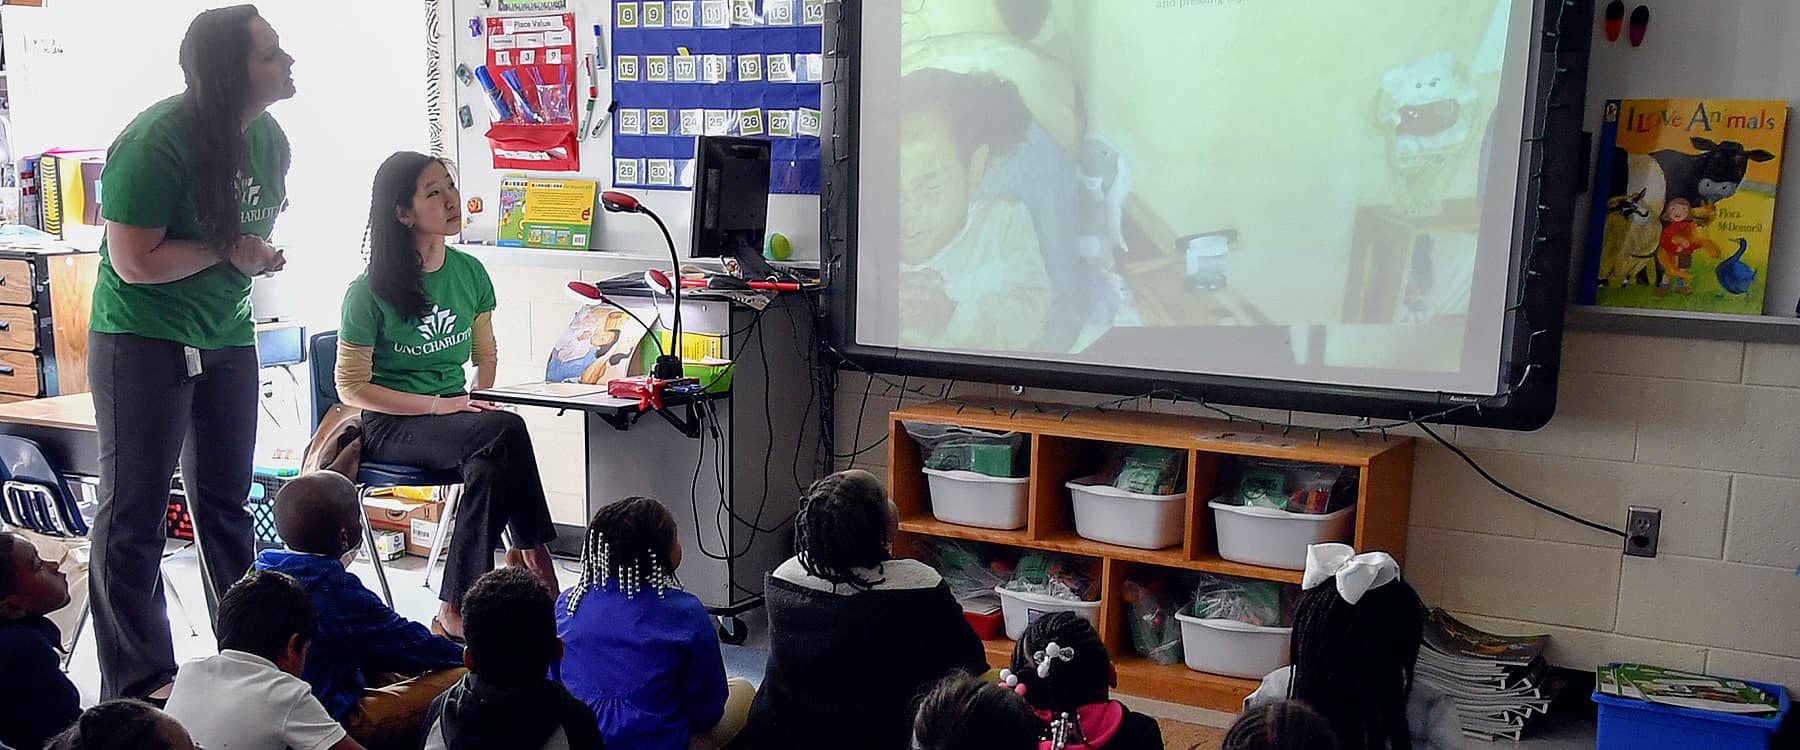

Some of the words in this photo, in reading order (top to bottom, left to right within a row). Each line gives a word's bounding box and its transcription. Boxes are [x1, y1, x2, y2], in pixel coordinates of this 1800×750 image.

[623, 9, 632, 20] 8
[649, 9, 657, 20] 9
[675, 9, 689, 20] 10
[706, 8, 720, 20] 11
[735, 6, 749, 18] 12
[773, 7, 787, 18] 13
[807, 6, 822, 17] 14
[500, 53, 505, 62] 1
[524, 52, 530, 61] 3
[622, 63, 634, 74] 15
[651, 63, 664, 74] 16
[678, 62, 691, 74] 17
[742, 62, 757, 73] 19
[771, 62, 786, 72] 20
[623, 117, 636, 126] 22
[651, 117, 664, 126] 23
[709, 117, 723, 127] 25
[743, 116, 758, 127] 26
[772, 118, 787, 128] 27
[802, 116, 817, 128] 28
[1626, 106, 1635, 131] I
[1686, 102, 1775, 132] Animals
[620, 166, 634, 176] 29
[652, 167, 665, 176] 30
[1719, 208, 1741, 218] Flora
[394, 342, 421, 355] UNC
[422, 326, 472, 354] CHARLOTT
